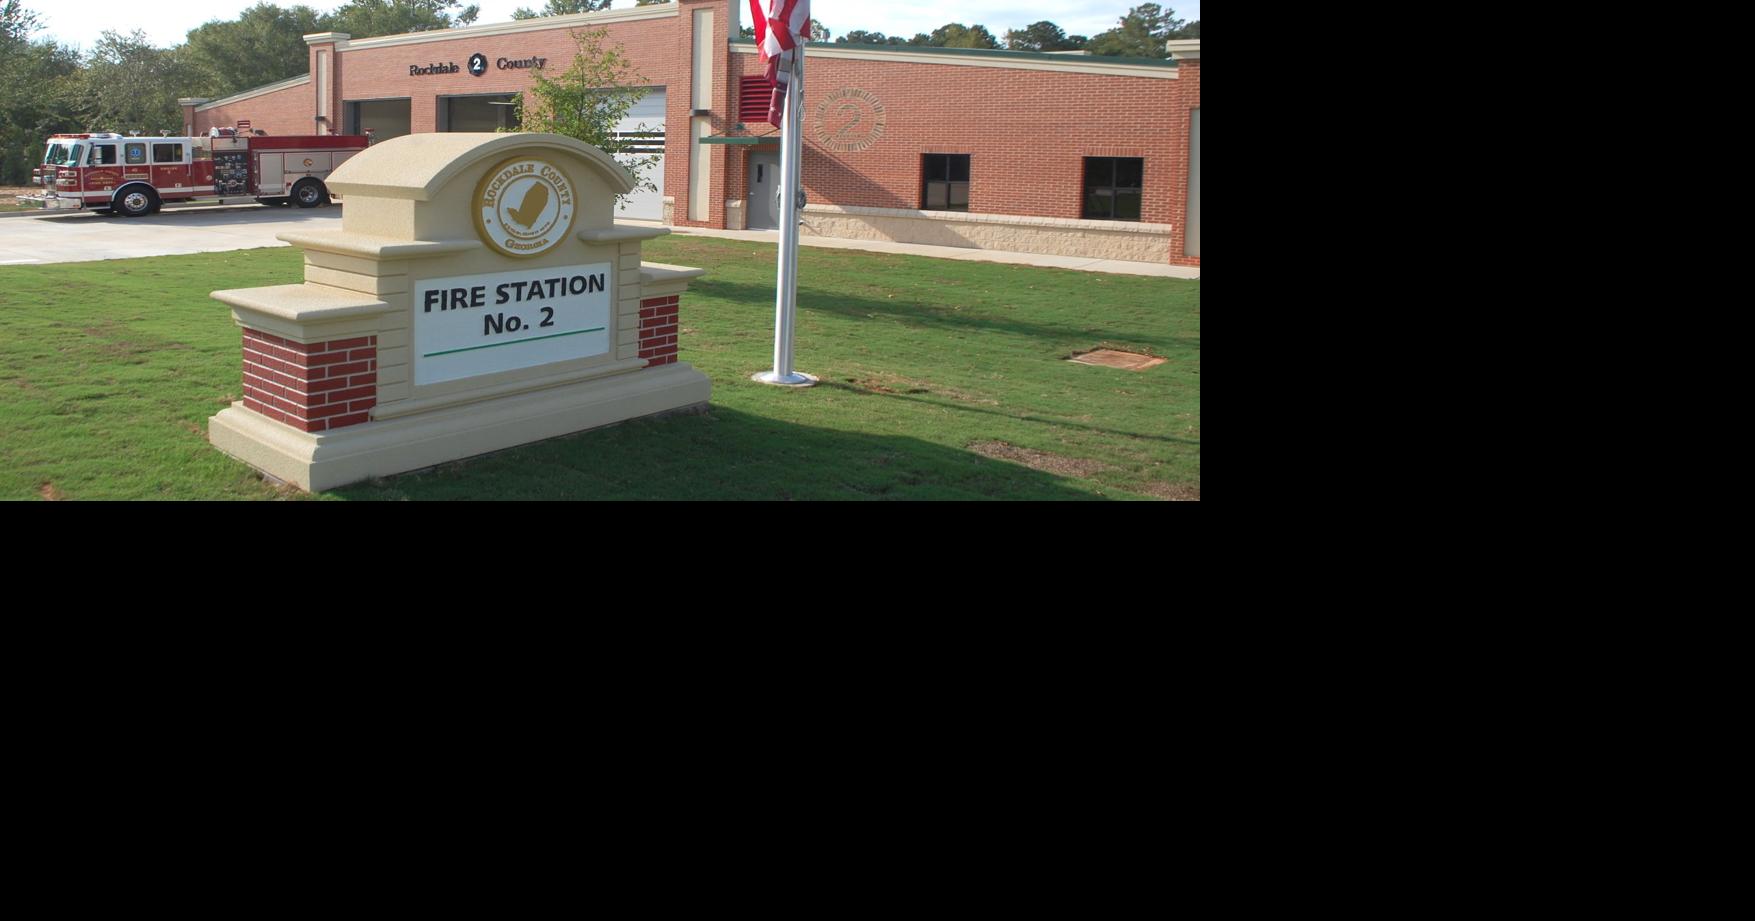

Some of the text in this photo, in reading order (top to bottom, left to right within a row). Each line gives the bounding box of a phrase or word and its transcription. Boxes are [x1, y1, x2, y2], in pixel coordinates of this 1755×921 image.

[409, 55, 548, 76] Rockdale 2 County
[836, 103, 862, 138] 2
[482, 163, 571, 208] ROCKDALE COUNTY
[424, 273, 605, 313] FIRE STATION
[484, 306, 555, 336] No. 2
